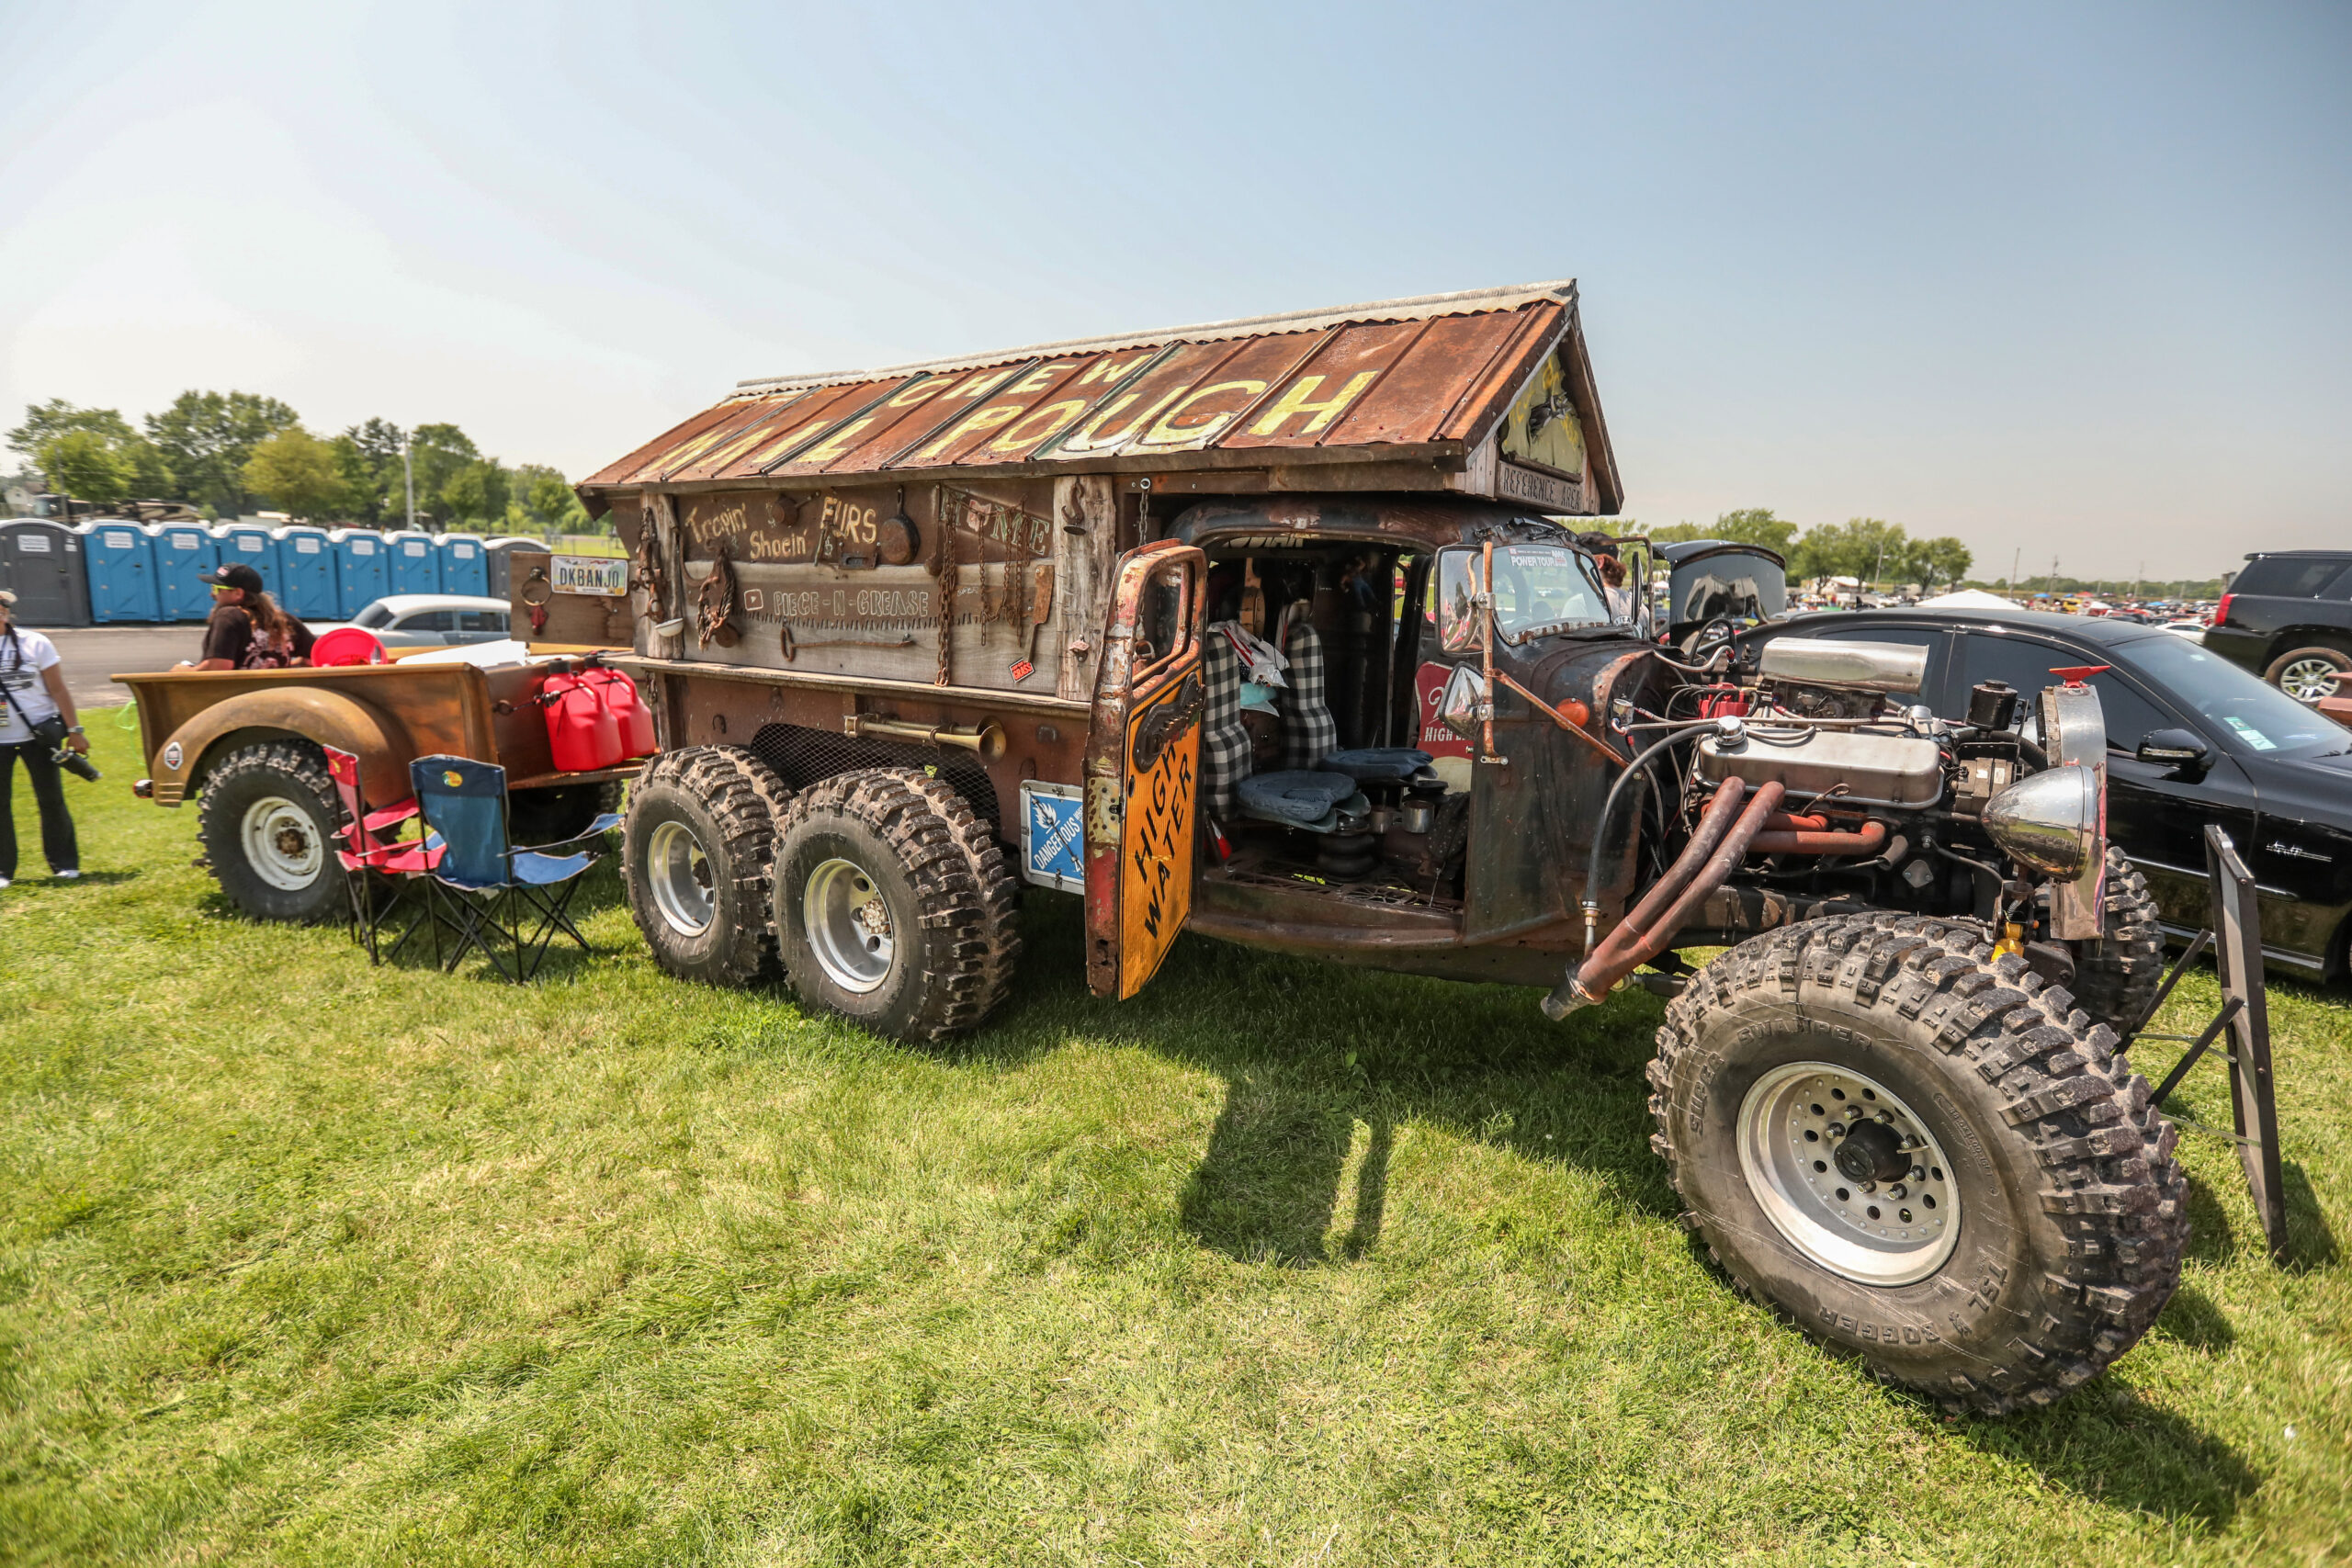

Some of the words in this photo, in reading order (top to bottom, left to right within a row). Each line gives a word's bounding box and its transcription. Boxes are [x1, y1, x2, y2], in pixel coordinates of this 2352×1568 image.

[888, 354, 1153, 407] CHEW
[919, 370, 1378, 458] POUCH
[1503, 467, 1555, 503] REFERENCE
[1562, 483, 1581, 510] AREA
[820, 496, 876, 544] FURS
[560, 567, 619, 588] DKBANJO
[1510, 556, 1537, 567] POWER
[1537, 557, 1555, 567] TOUR
[1425, 727, 1453, 741] HIGH
[1144, 752, 1193, 939] WATER
[1736, 1017, 1873, 1053] SWAMPER
[1690, 1051, 1725, 1136] SUPER
[1819, 1305, 1940, 1344] BOGGER
